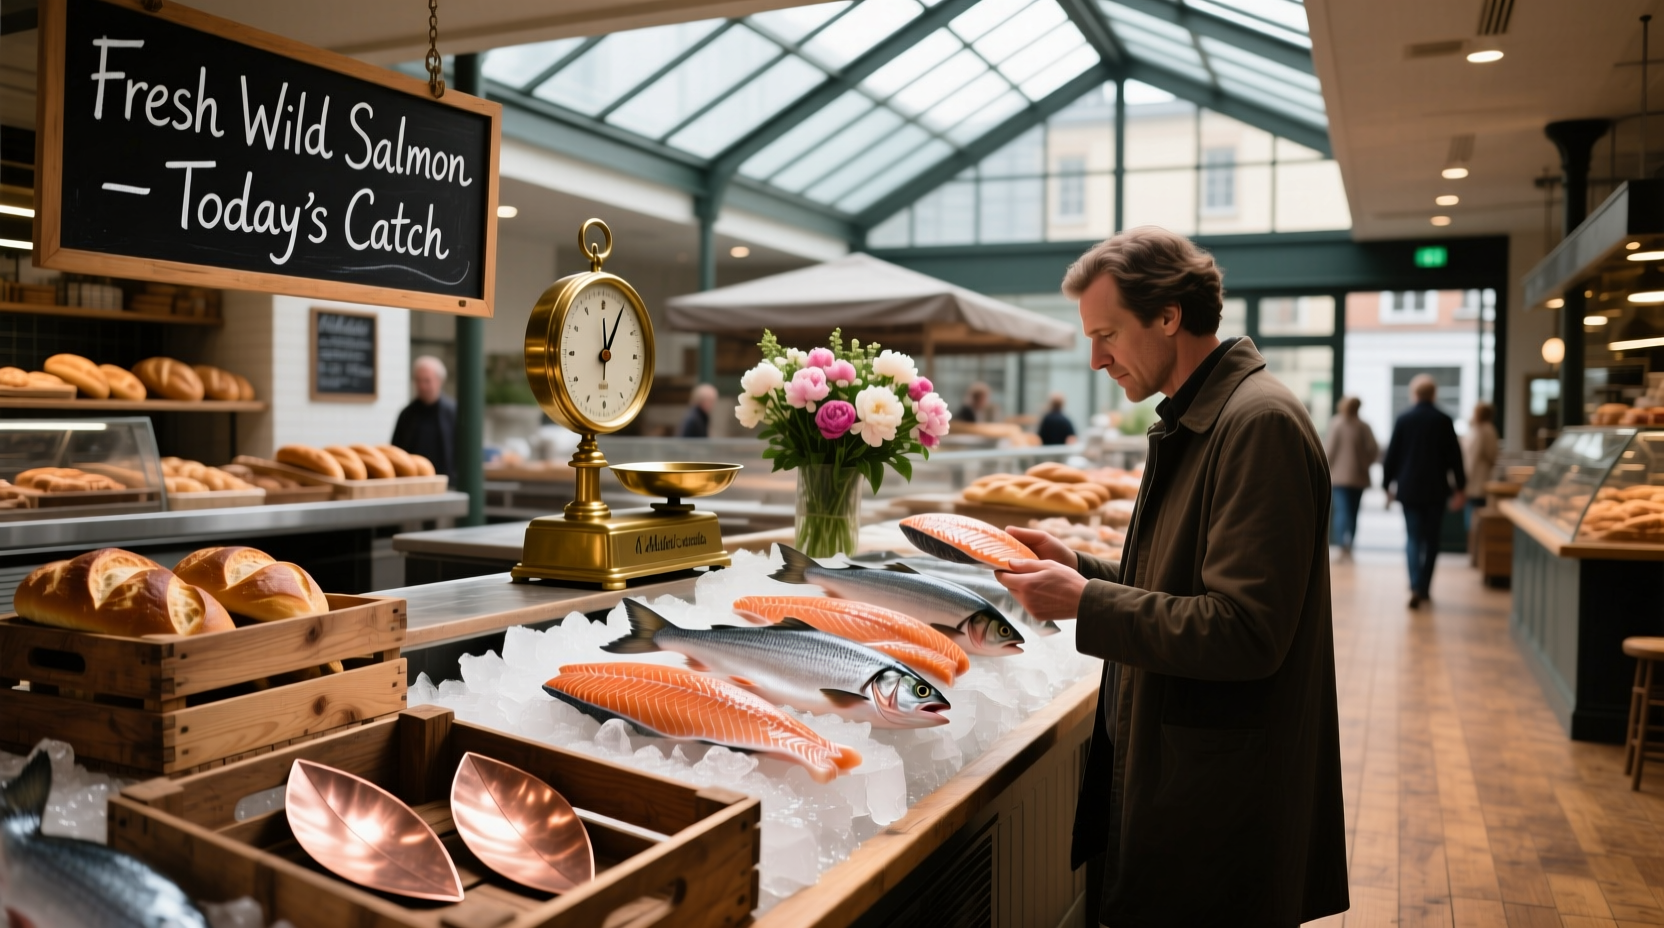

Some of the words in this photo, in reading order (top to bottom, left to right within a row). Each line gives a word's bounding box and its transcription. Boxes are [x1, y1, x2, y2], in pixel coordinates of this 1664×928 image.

[91, 36, 225, 138] Fresh
[241, 75, 334, 160] Wild
[345, 102, 473, 187] Salmon
[165, 160, 329, 265] Today's
[345, 187, 450, 260] Catch
